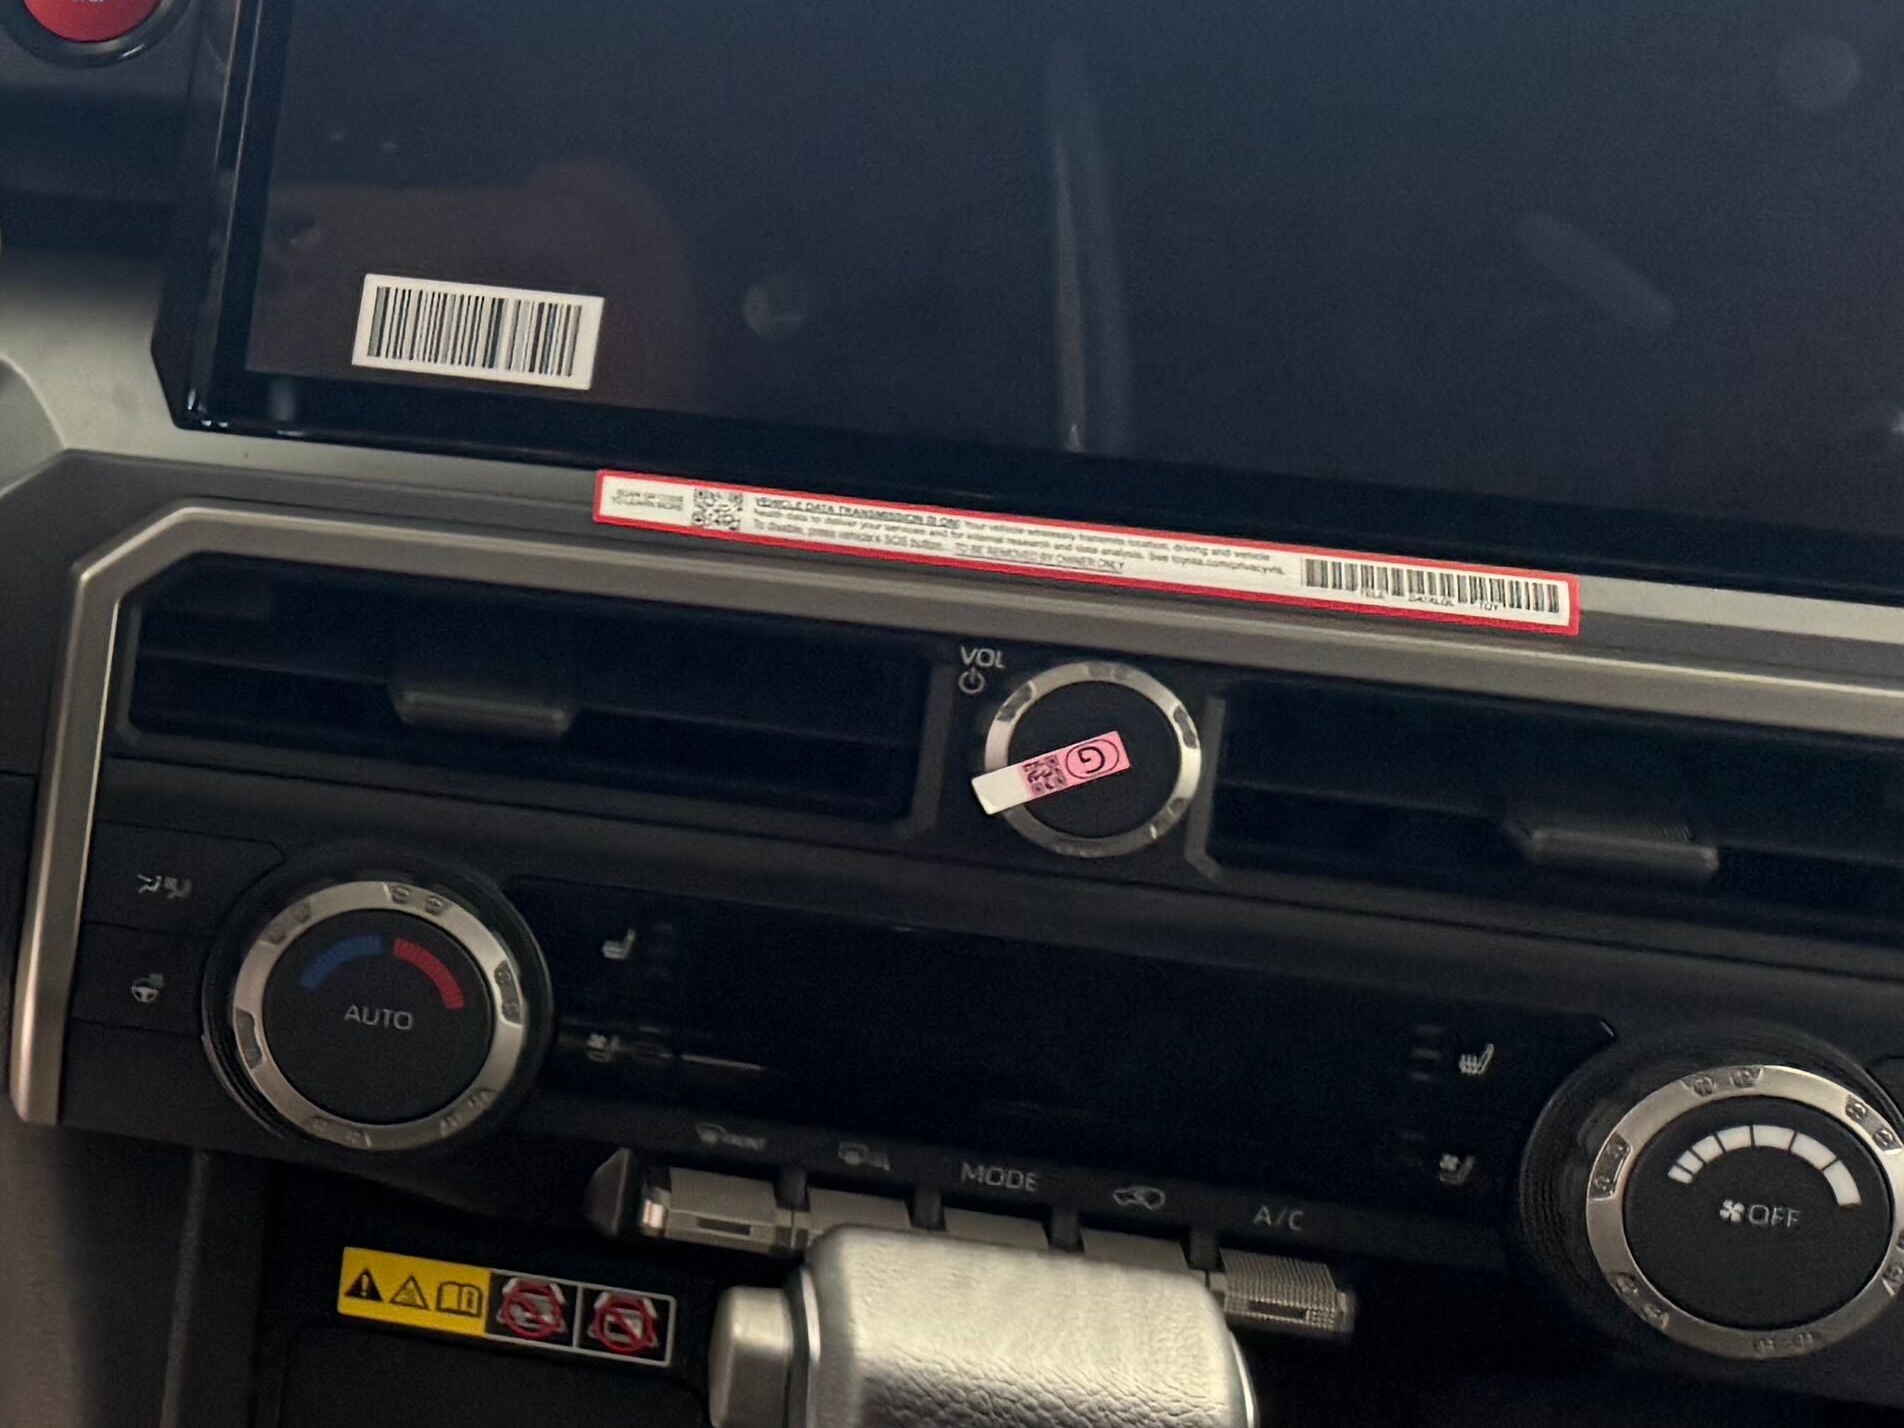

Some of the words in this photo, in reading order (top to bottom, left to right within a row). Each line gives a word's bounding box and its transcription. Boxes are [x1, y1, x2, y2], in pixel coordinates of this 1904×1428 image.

[805, 502, 834, 514] DATA
[960, 646, 1005, 670] VOL
[343, 1003, 414, 1033] AUTO
[960, 1162, 1041, 1193] MODE
[1252, 1204, 1305, 1232] A/C
[1747, 1203, 1801, 1228] OFF
